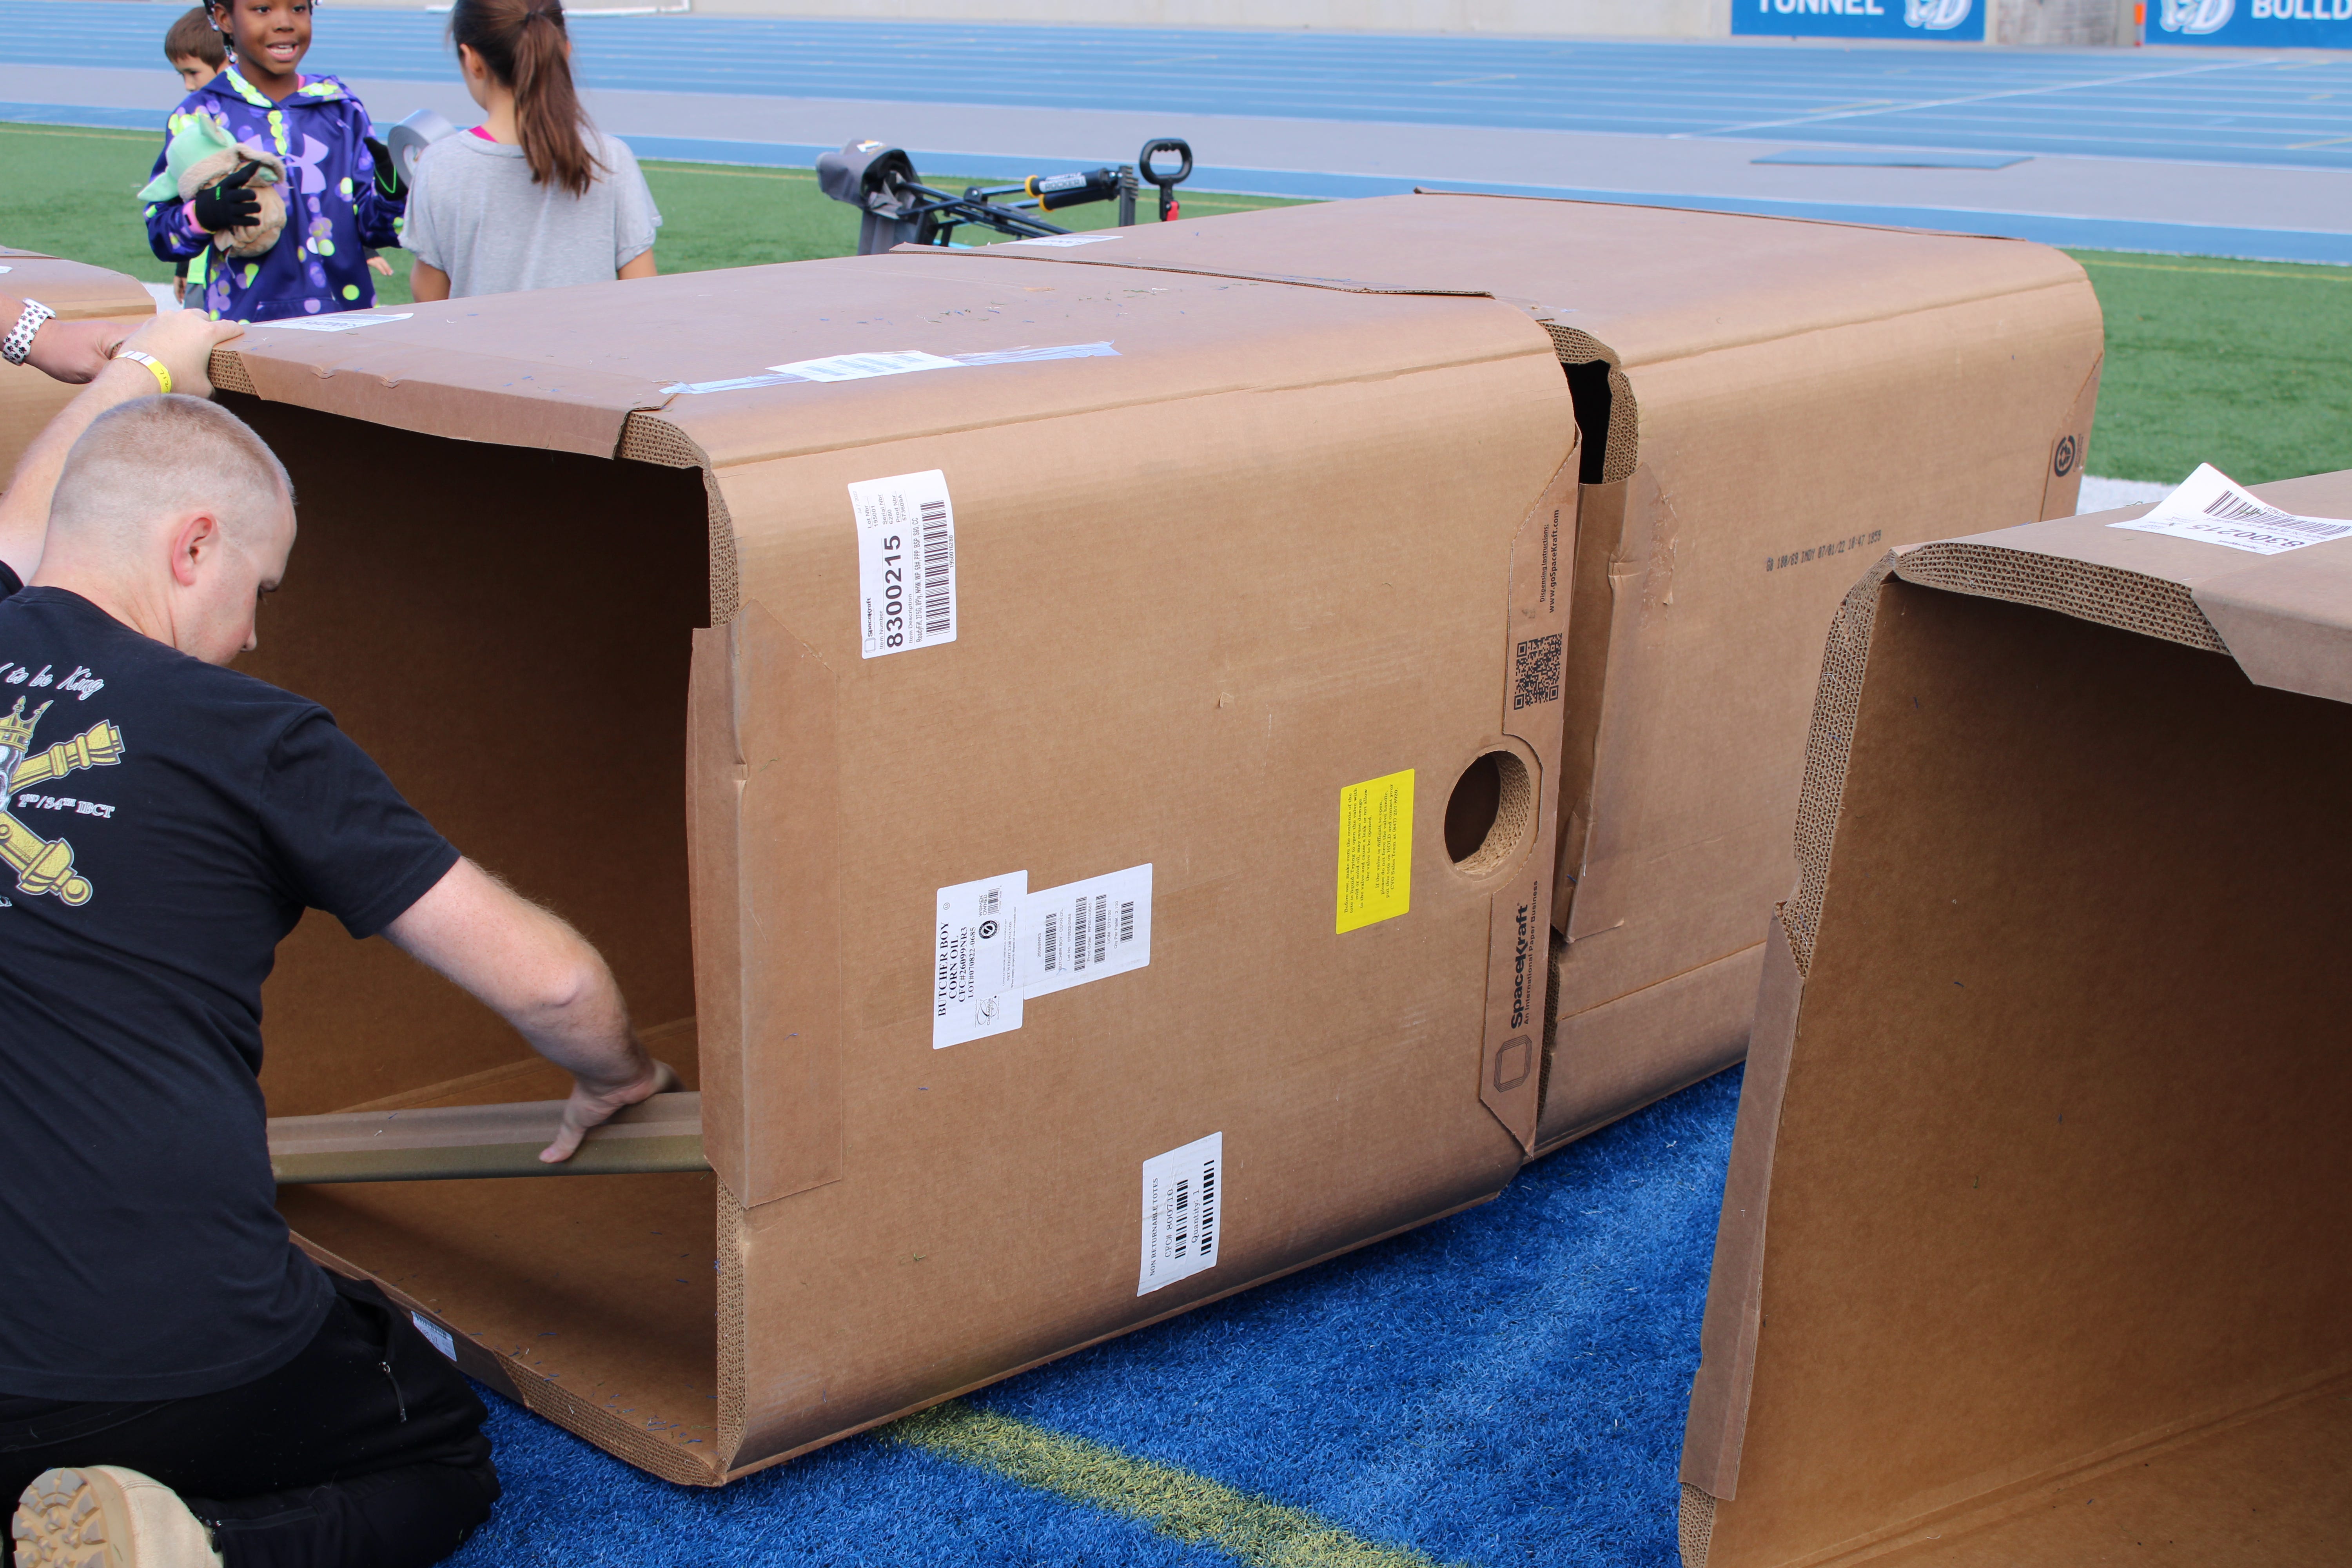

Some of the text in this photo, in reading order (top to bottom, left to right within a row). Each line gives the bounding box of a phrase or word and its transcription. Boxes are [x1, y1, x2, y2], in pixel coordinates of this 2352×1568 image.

[898, 494, 907, 521] 573609A
[1549, 510, 1559, 613] www.goSpaceKraft.com
[2185, 524, 2305, 547] 8300215
[884, 535, 903, 648] 8300215
[5, 667, 29, 684] to
[29, 664, 53, 687] be
[57, 666, 105, 701] King
[76, 800, 116, 818] IBCT
[938, 922, 949, 1016] BUTCHER BOY
[949, 935, 958, 999] CORN OIL
[958, 926, 967, 1002] CFC#26099NR3
[1510, 905, 1528, 1029] SpaceKraft
[1524, 1013, 1529, 1025] An
[1191, 1200, 1200, 1243] Quantity:
